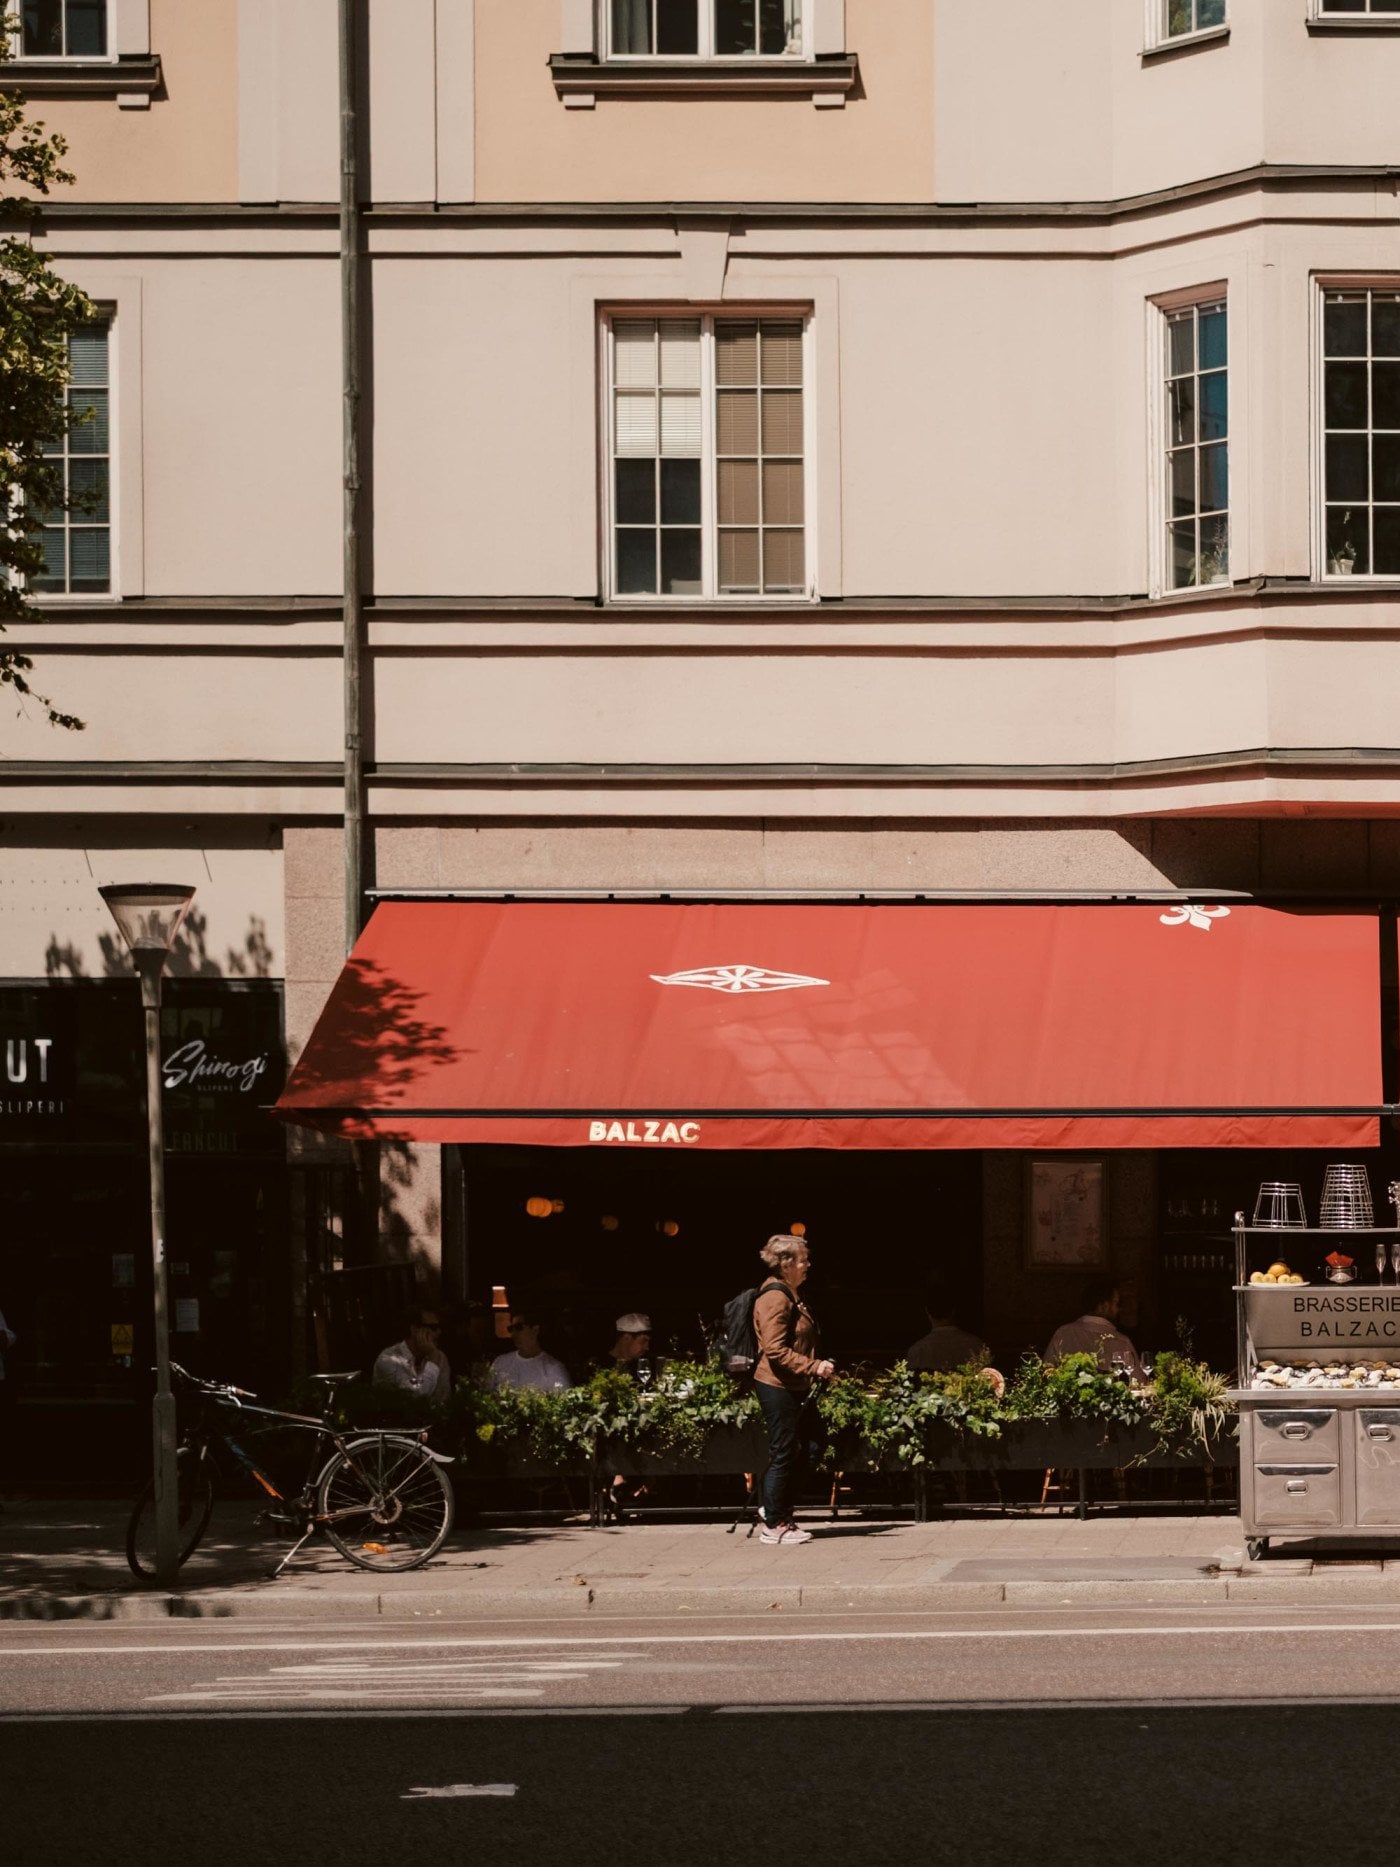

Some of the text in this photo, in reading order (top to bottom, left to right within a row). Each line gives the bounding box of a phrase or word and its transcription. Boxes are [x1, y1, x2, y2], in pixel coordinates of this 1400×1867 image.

[7, 1039, 52, 1082] UT
[162, 1040, 268, 1091] Shinogi
[589, 1121, 700, 1143] BALZAC
[1301, 1321, 1396, 1336] BALZAC
